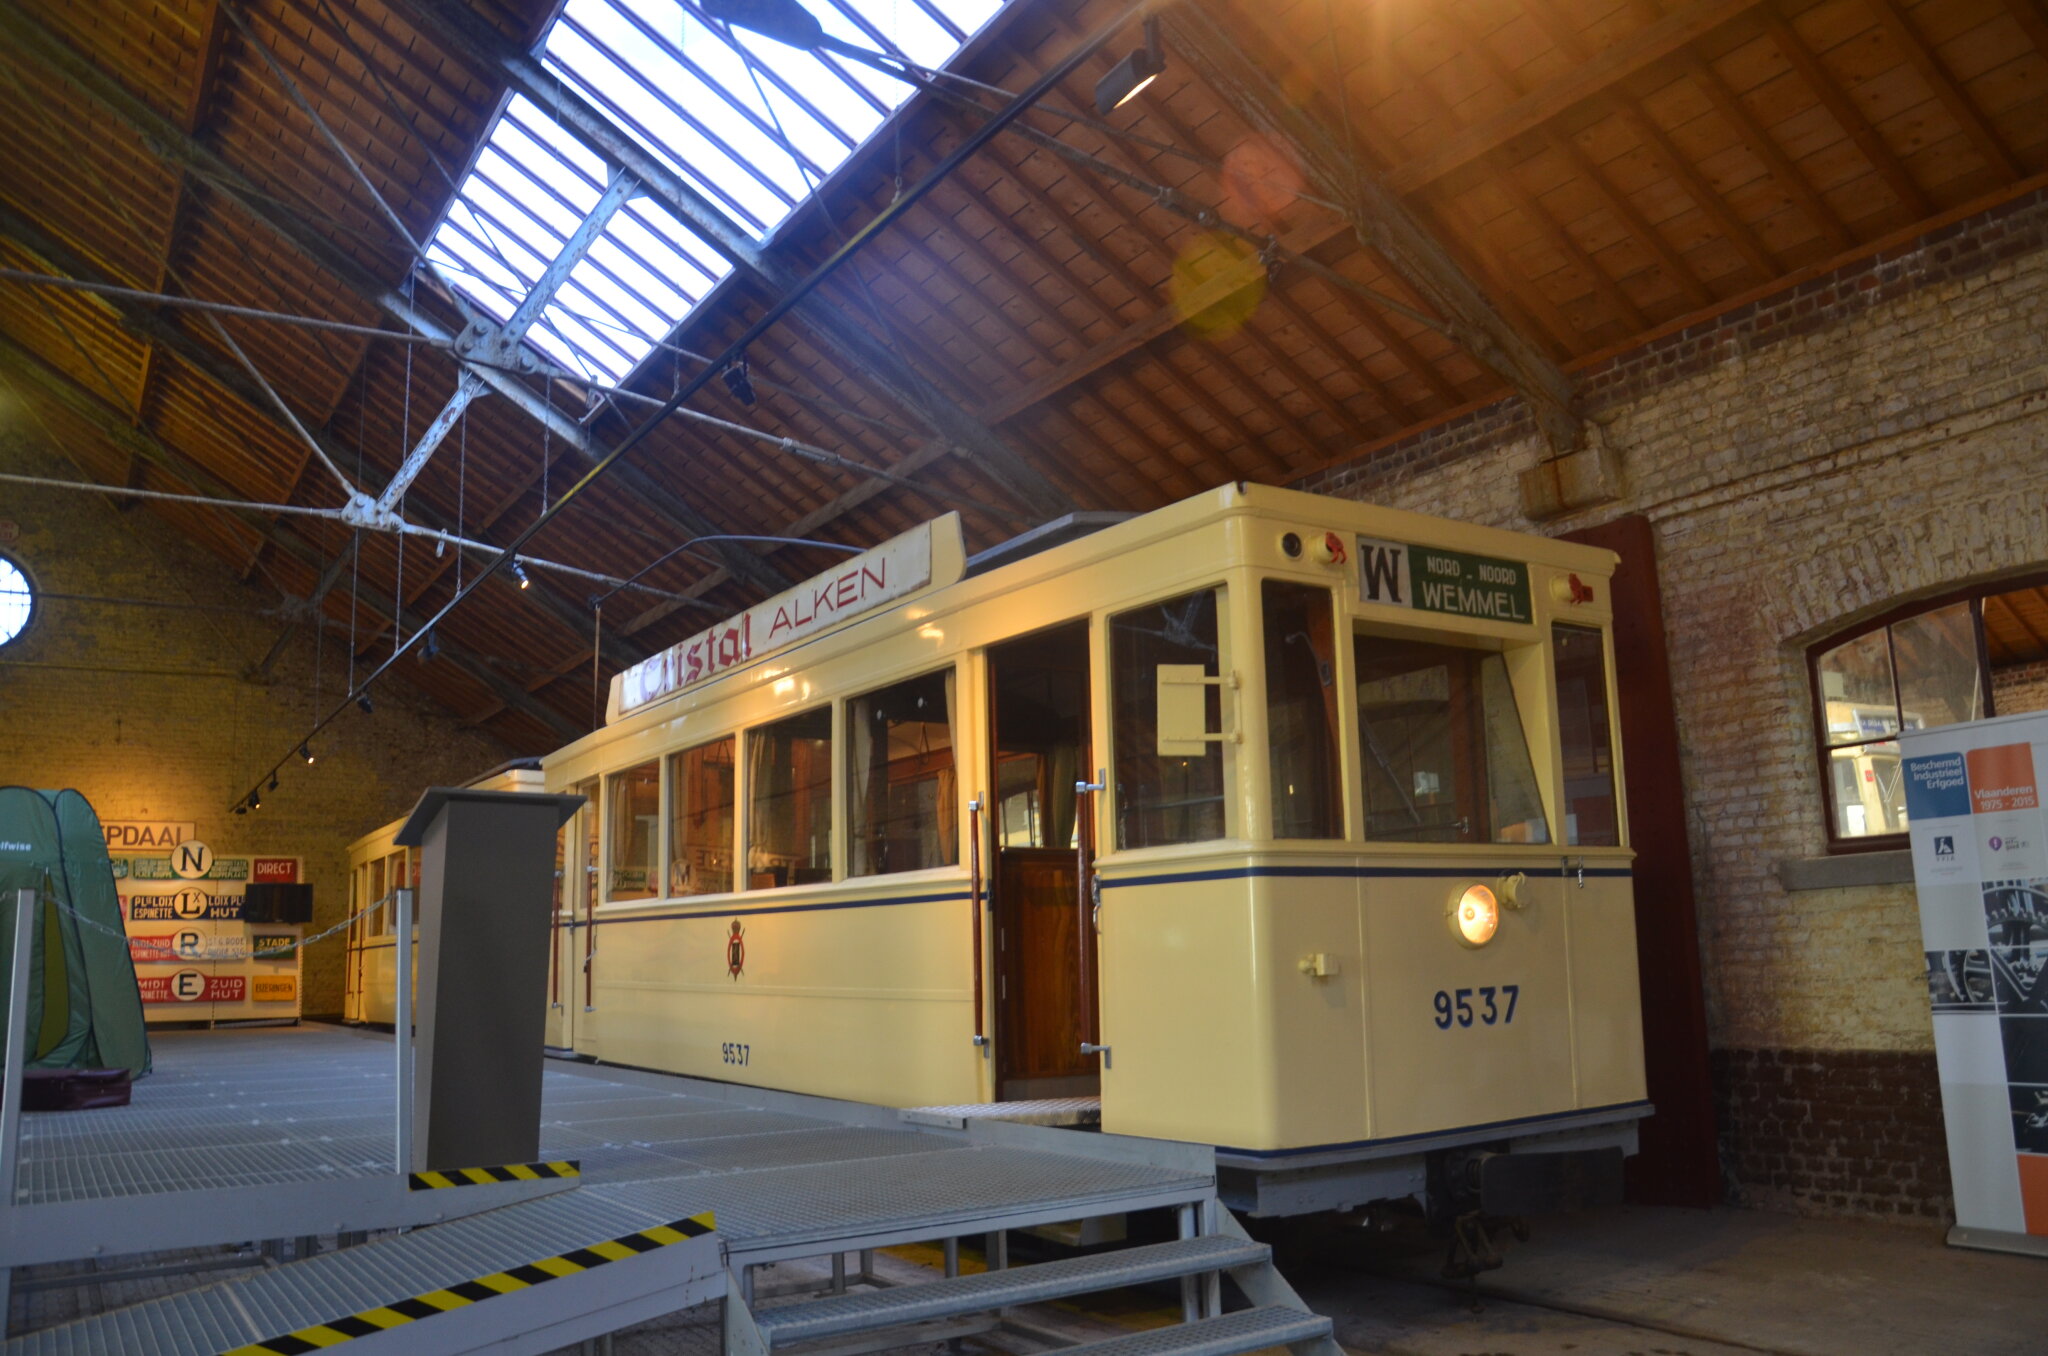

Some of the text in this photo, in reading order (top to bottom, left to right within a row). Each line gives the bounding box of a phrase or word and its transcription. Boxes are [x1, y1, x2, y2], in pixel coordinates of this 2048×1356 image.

[1361, 544, 1402, 604] W
[1426, 556, 1460, 577] NORD
[1479, 564, 1516, 585] NOORD
[769, 557, 885, 638] ALKEN
[1422, 581, 1525, 619] WEMMEL
[1910, 756, 1961, 772] Beschermd
[1913, 766, 1963, 781] Industrieel
[1927, 776, 1964, 790] Erfgoed
[1974, 786, 2033, 799] Vlaanderen
[1980, 798, 2002, 810] 1975
[2012, 796, 2034, 808] 2015
[0, 841, 31, 851] lfwise
[181, 846, 204, 872] N
[257, 862, 293, 875] DIRECT
[153, 896, 174, 907] LOIX
[208, 895, 229, 906] LOIX
[134, 908, 173, 919] ESPINETTE
[210, 907, 239, 918] HUT
[181, 933, 201, 957] R
[179, 974, 197, 995] E
[211, 979, 243, 988] ZUID
[211, 989, 240, 999] HUT
[1433, 984, 1519, 1030] 9537
[722, 1042, 750, 1067] 9537
